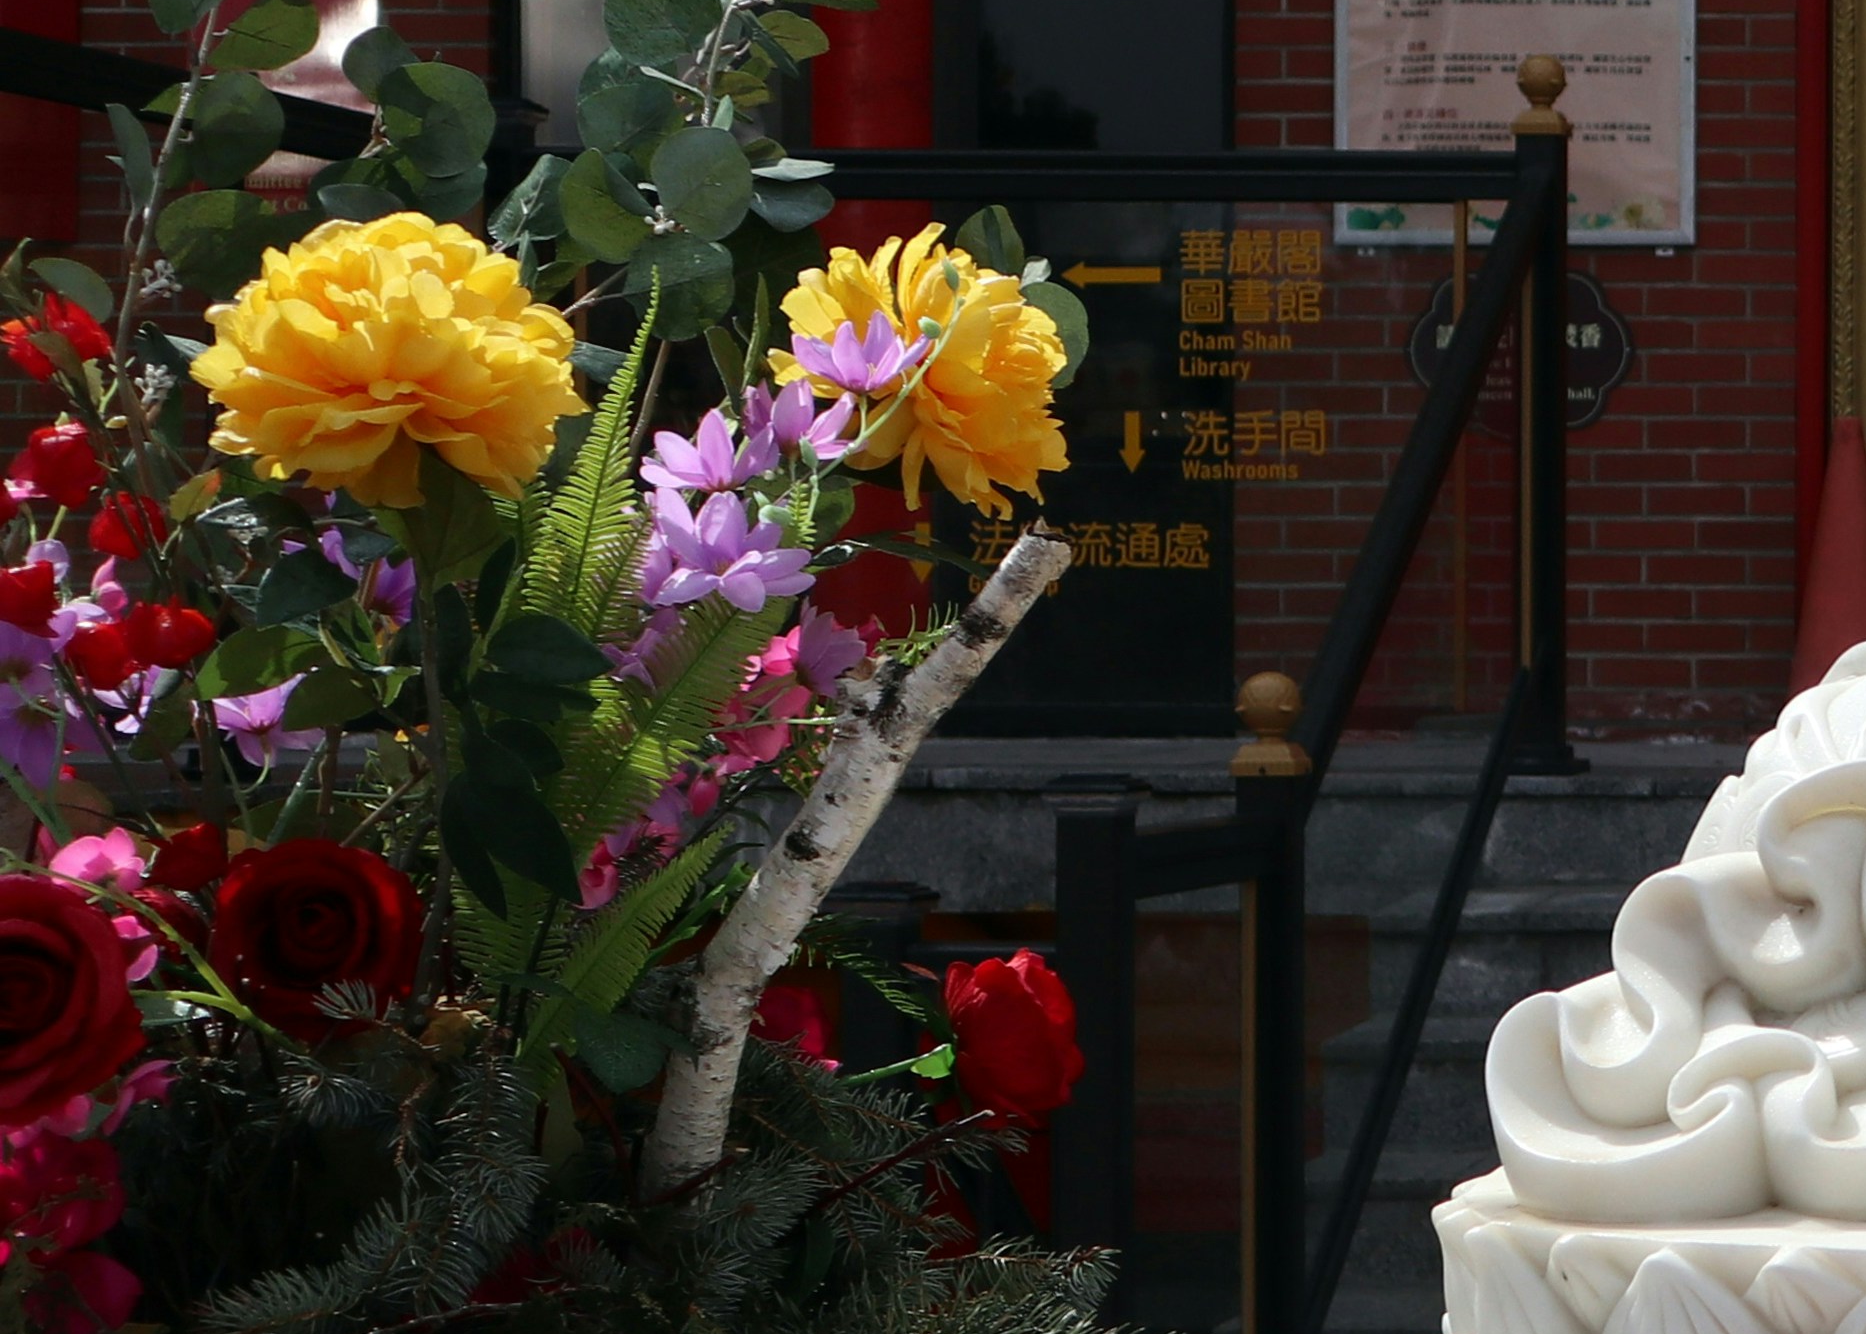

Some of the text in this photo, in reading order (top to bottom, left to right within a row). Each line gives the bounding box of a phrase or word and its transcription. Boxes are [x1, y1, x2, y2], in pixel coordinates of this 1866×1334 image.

[1180, 229, 1321, 275] 華嚴閣
[1180, 278, 1322, 324] 圖書館
[1179, 330, 1292, 352] Cham Shan
[1179, 356, 1252, 382] Library
[1182, 410, 1328, 456] 洗手間
[1182, 459, 1299, 481] Washrooms
[968, 519, 1212, 569] 法流通處
